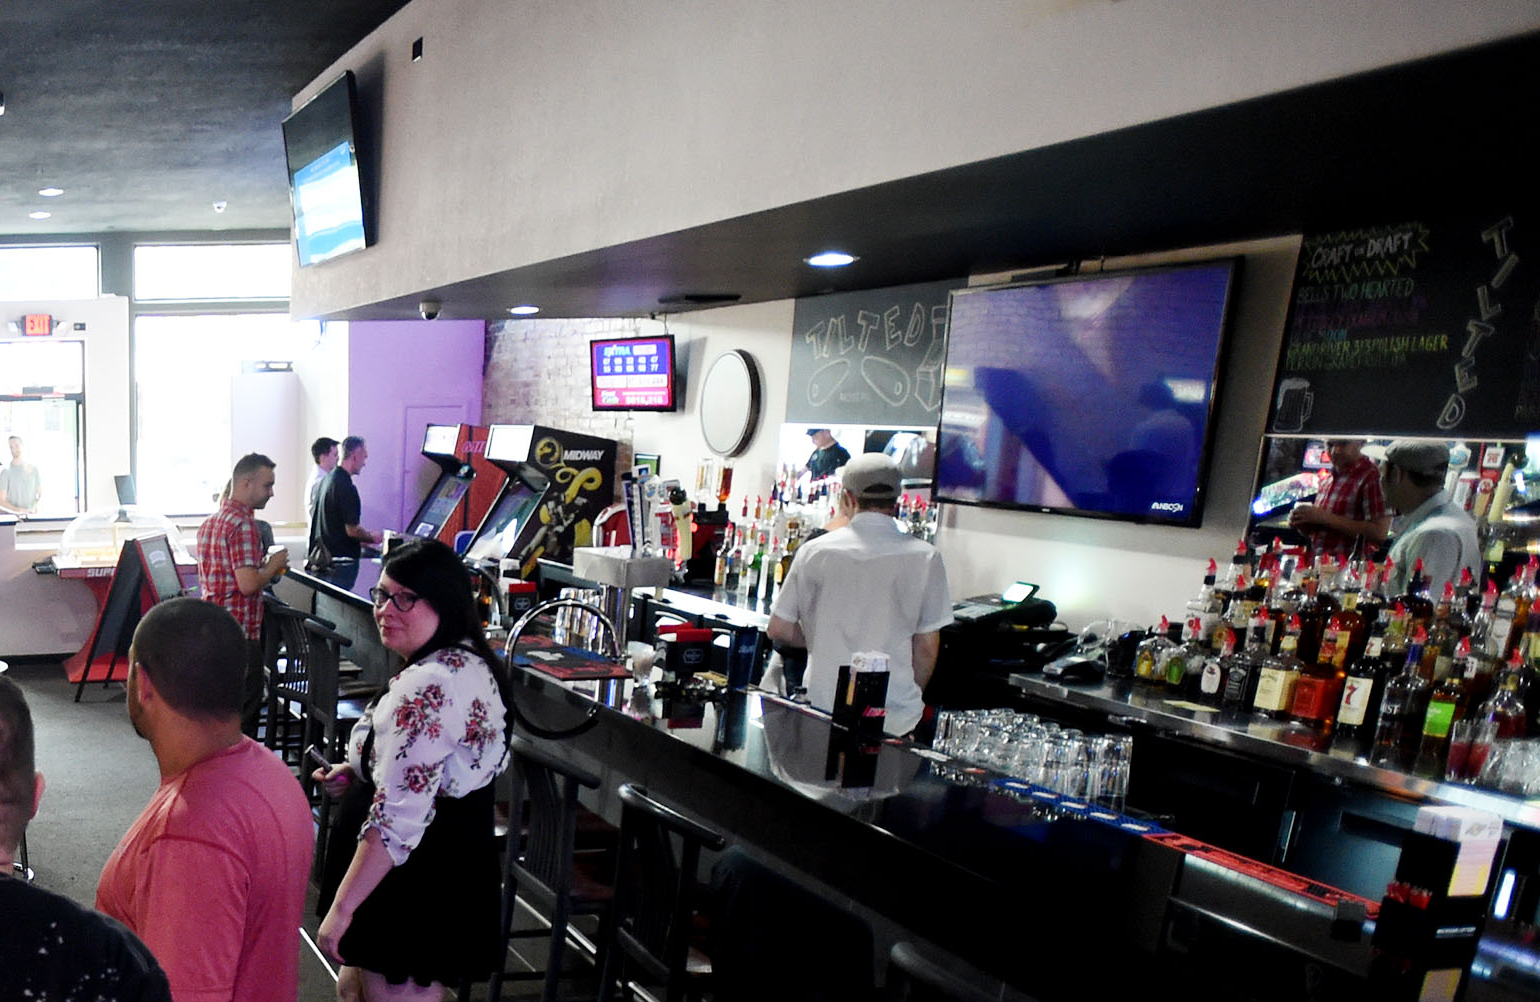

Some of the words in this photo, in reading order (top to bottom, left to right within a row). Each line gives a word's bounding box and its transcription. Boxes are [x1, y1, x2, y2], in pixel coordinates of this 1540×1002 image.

[1311, 243, 1354, 268] CRAFT
[1366, 231, 1413, 257] DRAFT
[27, 315, 50, 335] EXIT
[805, 302, 926, 360] TILTED
[563, 449, 605, 461] MIDWAY
